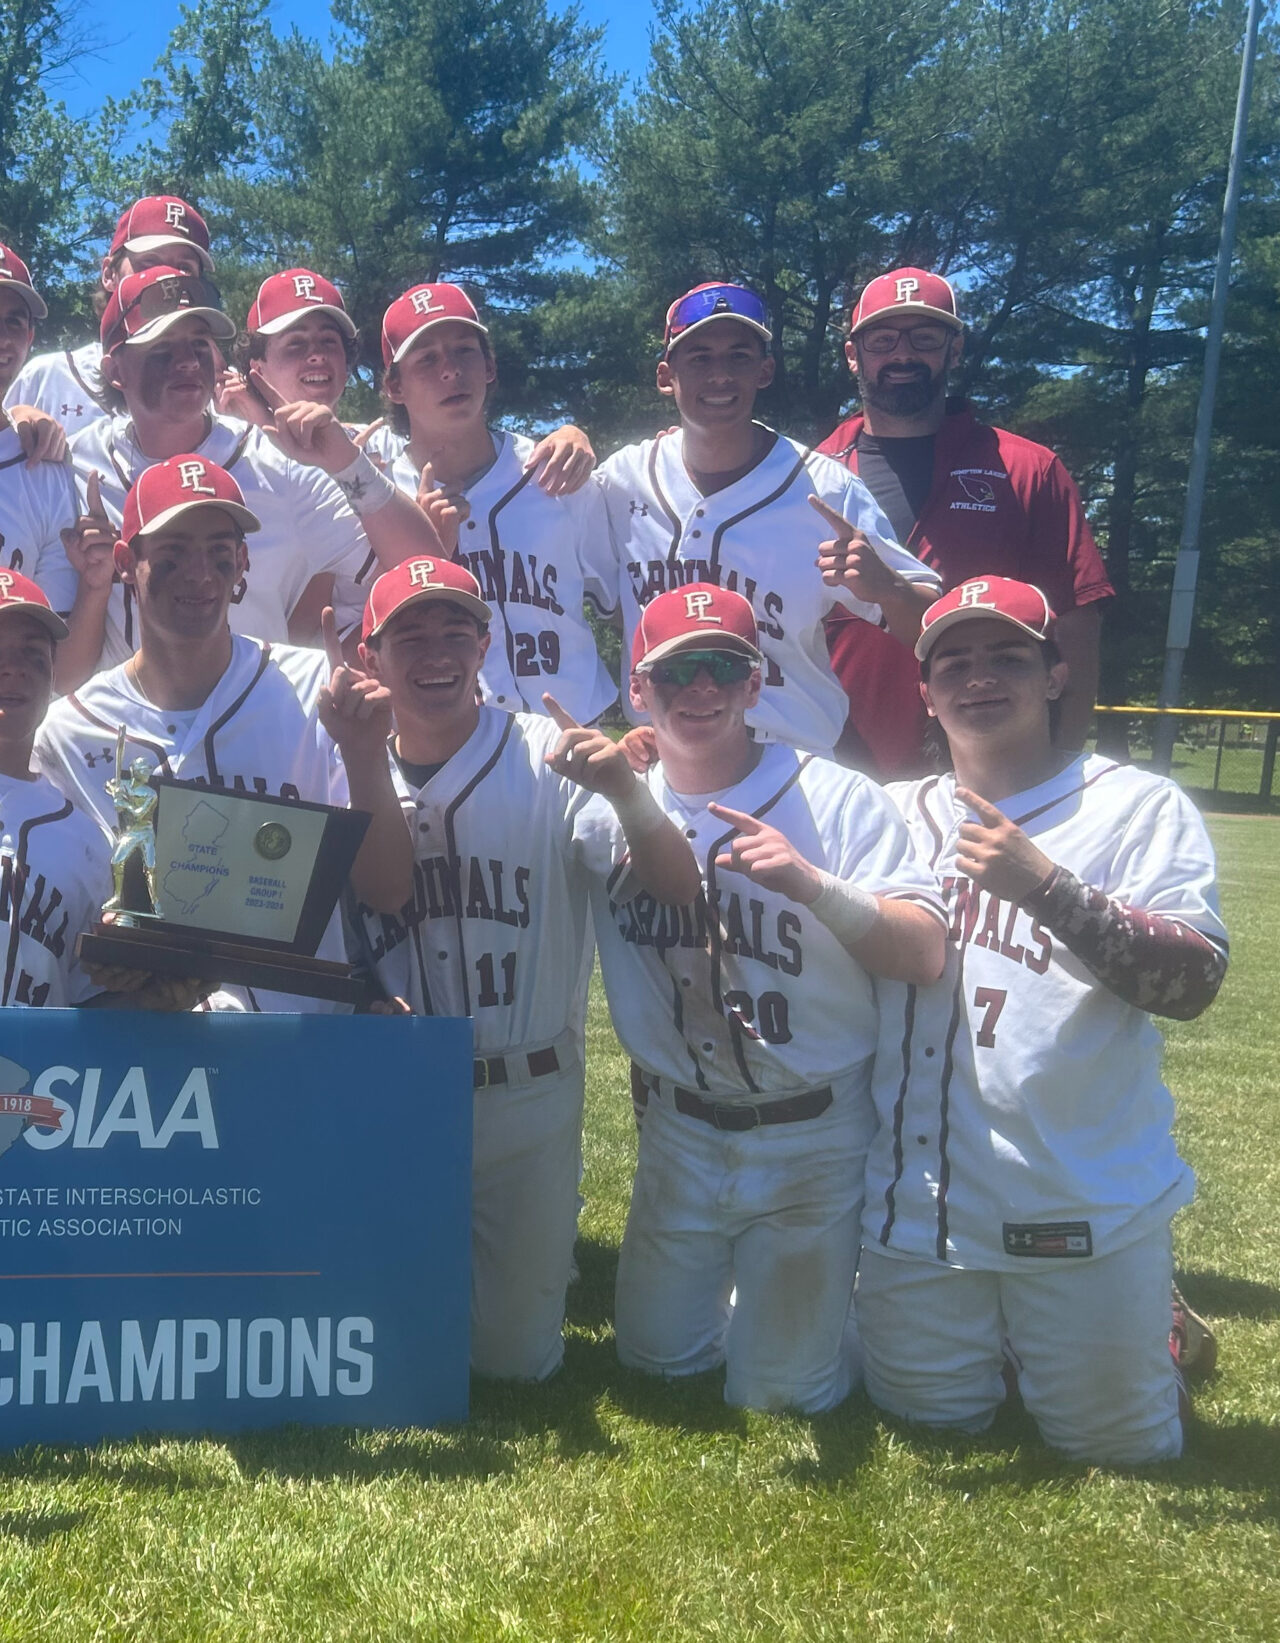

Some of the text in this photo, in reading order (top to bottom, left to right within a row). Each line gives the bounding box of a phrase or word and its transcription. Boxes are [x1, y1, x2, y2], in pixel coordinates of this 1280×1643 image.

[165, 202, 189, 233] PL
[291, 275, 323, 303] PL
[409, 288, 445, 315] PL
[894, 277, 924, 305] PL
[177, 461, 216, 496] PL
[949, 502, 997, 513] ATHLETICS
[406, 560, 444, 589] PL
[682, 591, 722, 624] PL
[959, 580, 997, 609] PL
[515, 630, 560, 676] 29
[188, 843, 218, 856] STATE
[170, 860, 230, 877] CHAMPIONS
[248, 875, 287, 889] BASEBALL
[250, 887, 278, 899] GROUP
[476, 952, 516, 1008] 11
[974, 986, 1008, 1048] 7
[3, 1098, 32, 1113] 1918
[66, 1187, 261, 1206] INTERSCHOLASTIC
[37, 1218, 182, 1237] ASSOCIATION
